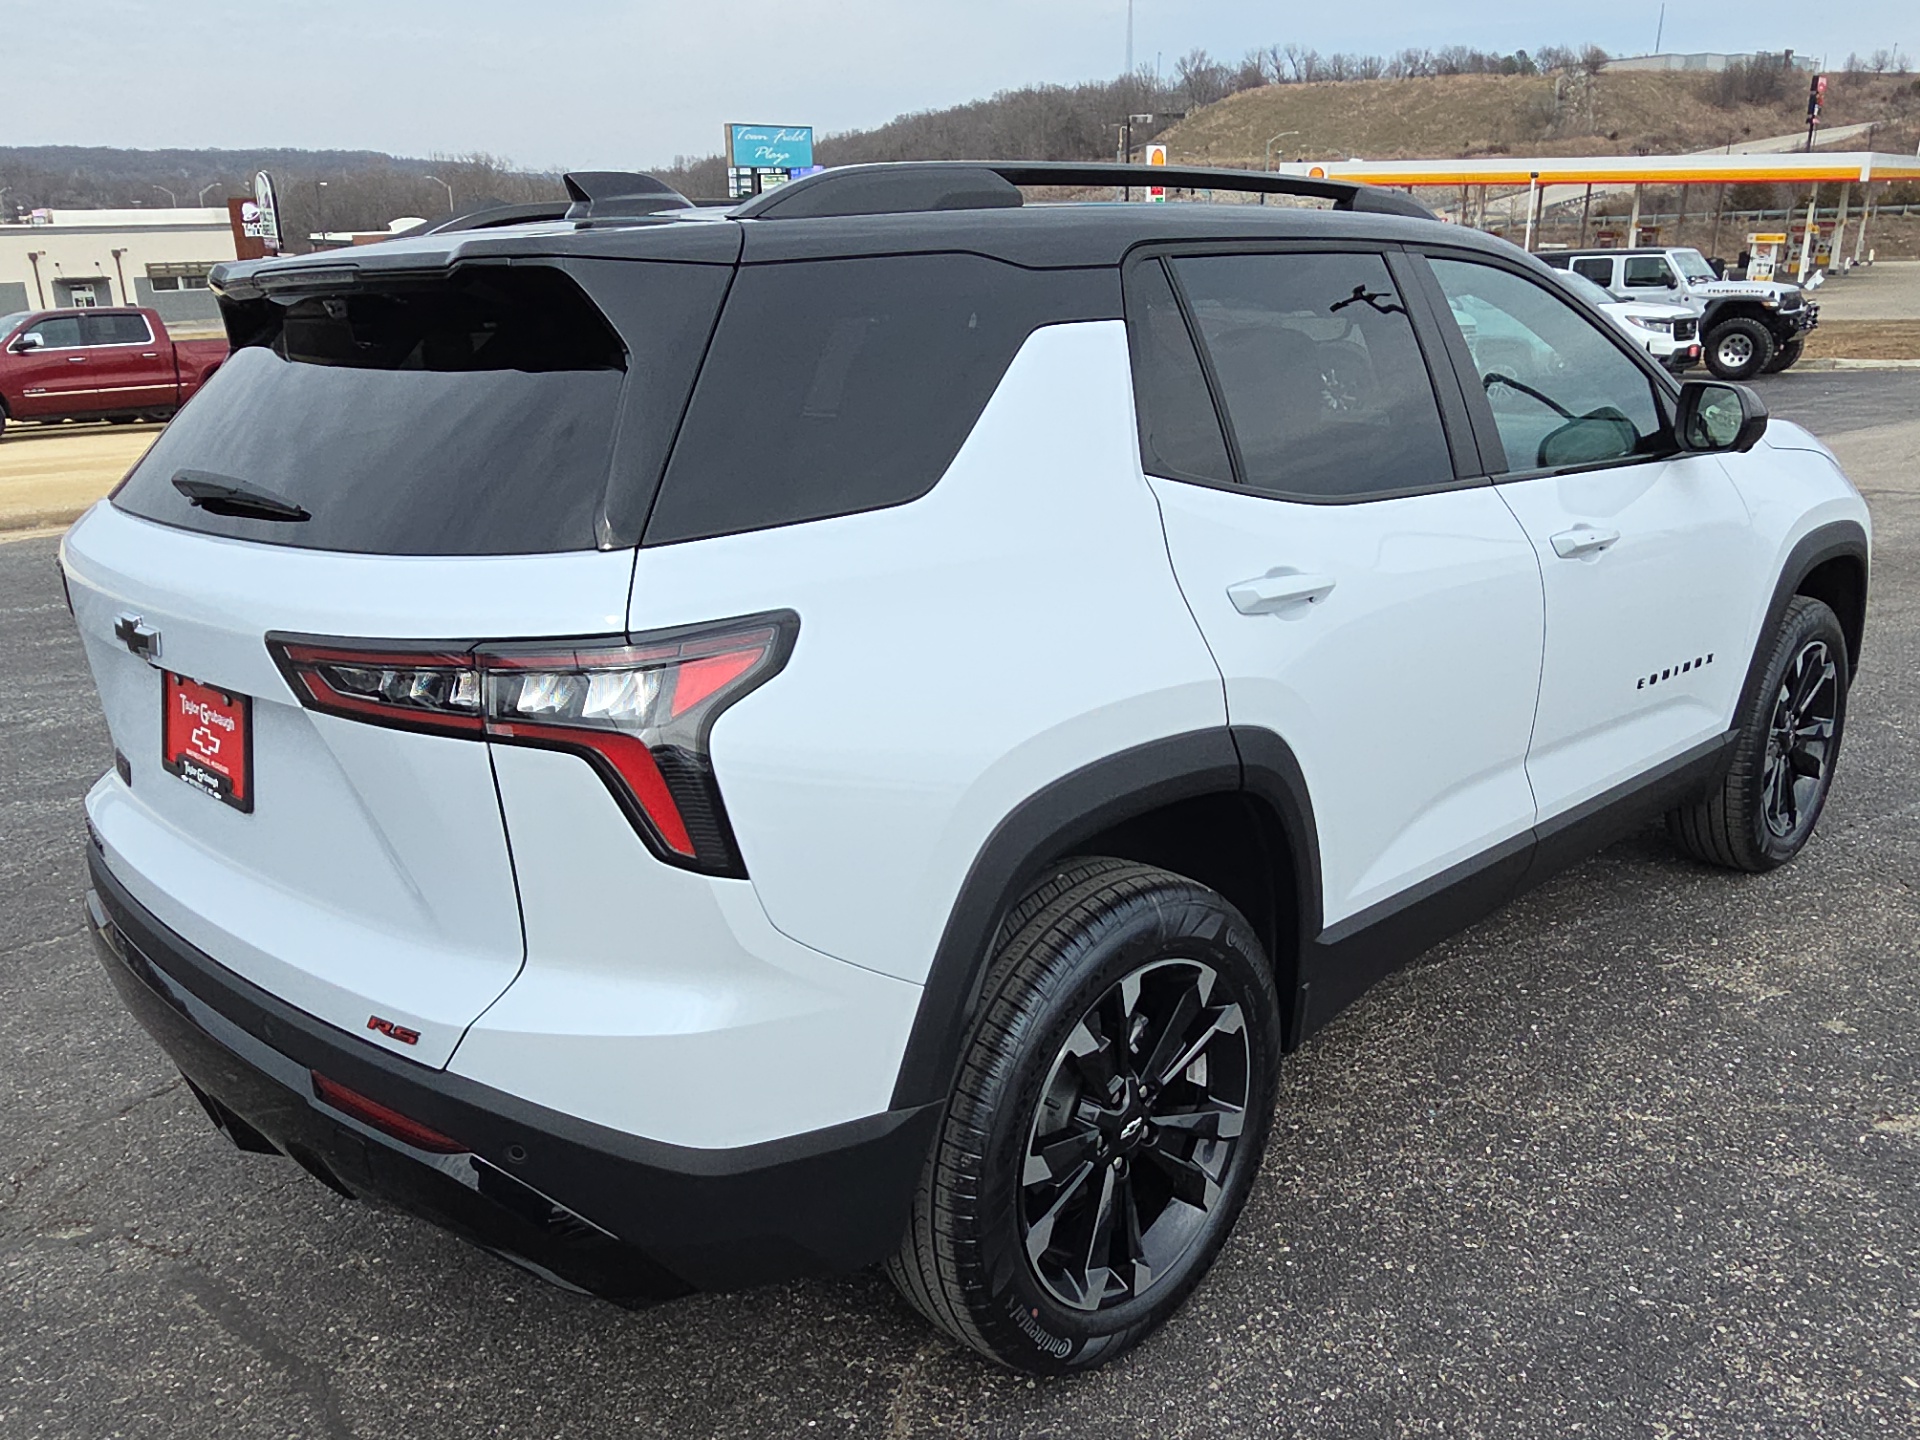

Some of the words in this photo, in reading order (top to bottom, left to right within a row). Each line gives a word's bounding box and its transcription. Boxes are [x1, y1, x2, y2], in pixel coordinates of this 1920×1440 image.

[1637, 653, 1714, 690] EQUINOX
[366, 1014, 421, 1046] RS
[1009, 1304, 1073, 1359] Continental
